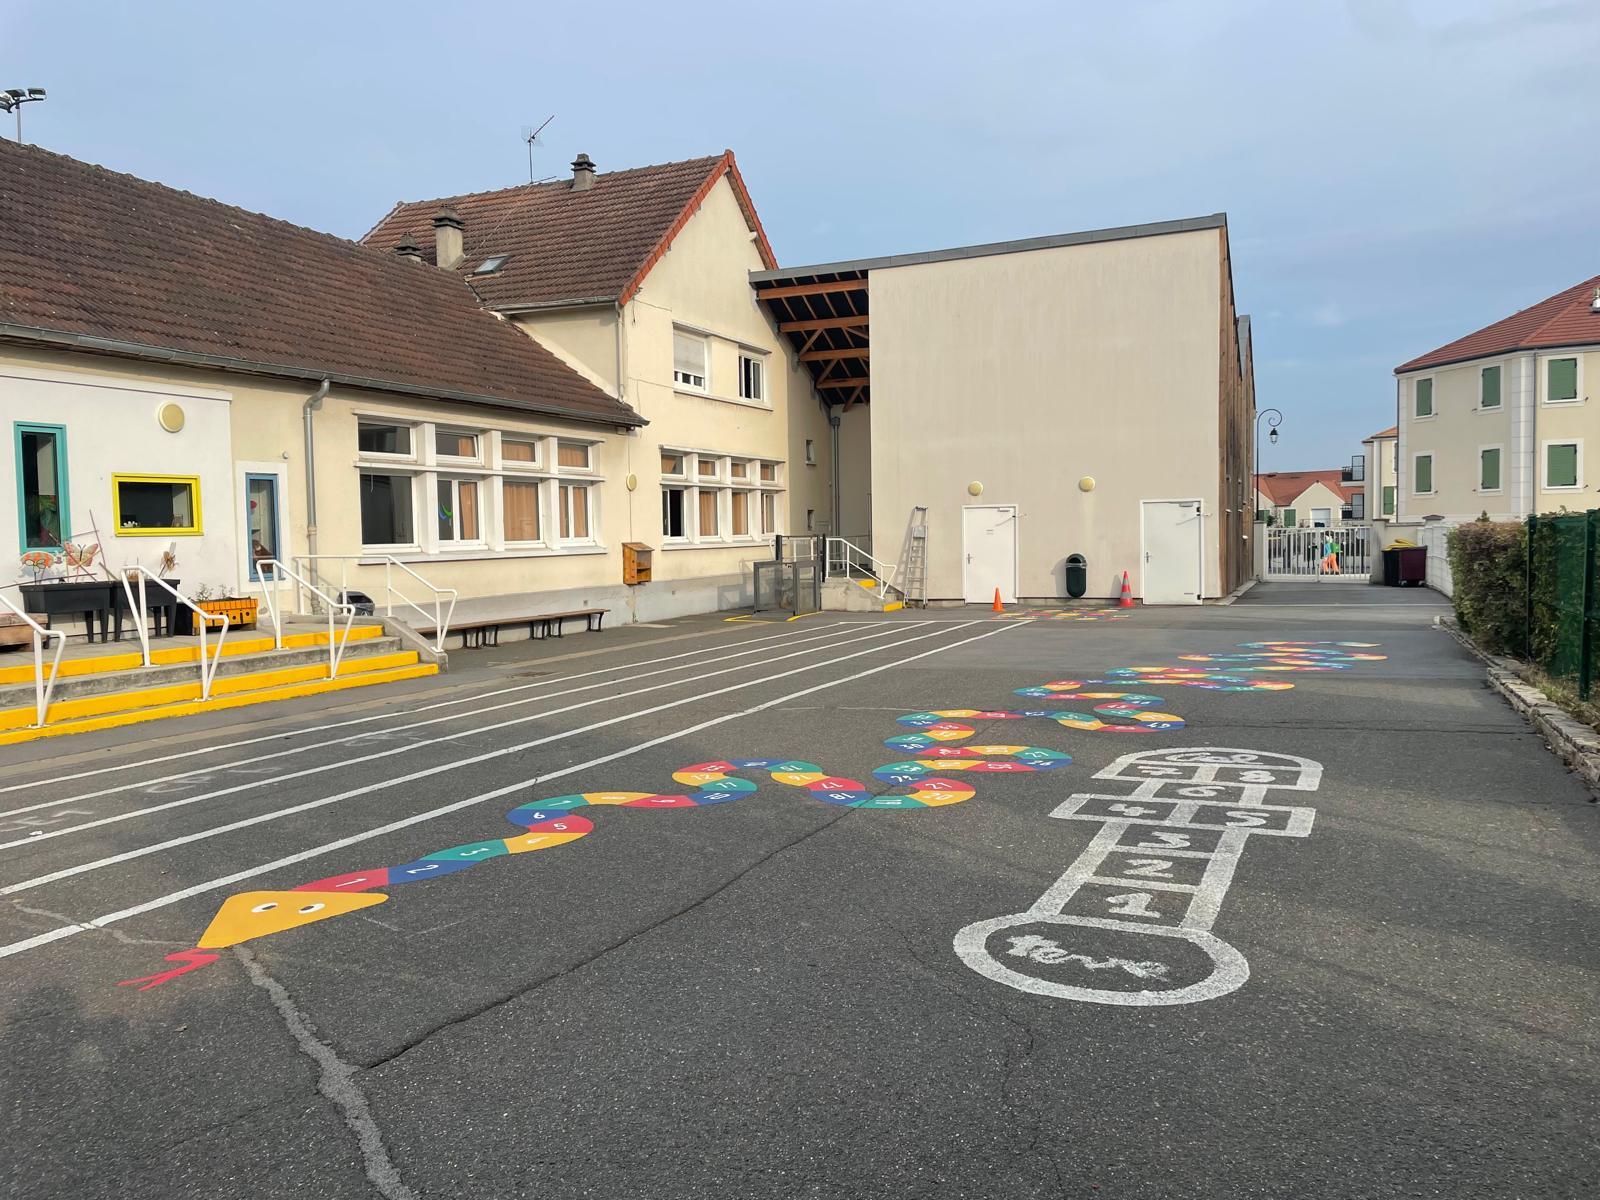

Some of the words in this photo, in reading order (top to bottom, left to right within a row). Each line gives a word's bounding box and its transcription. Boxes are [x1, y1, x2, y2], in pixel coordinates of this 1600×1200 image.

[1137, 765, 1183, 776] 7
[1239, 770, 1276, 783] 8
[1176, 786, 1226, 797] 6
[1108, 803, 1158, 817] 4
[533, 812, 546, 820] 6
[1224, 811, 1271, 827] 5
[553, 823, 568, 831] 5
[1137, 830, 1191, 848] 3
[460, 847, 491, 857] 3
[406, 864, 439, 874] 2
[1123, 858, 1174, 878] 2
[335, 878, 367, 888] 1
[1105, 892, 1162, 918] 1
